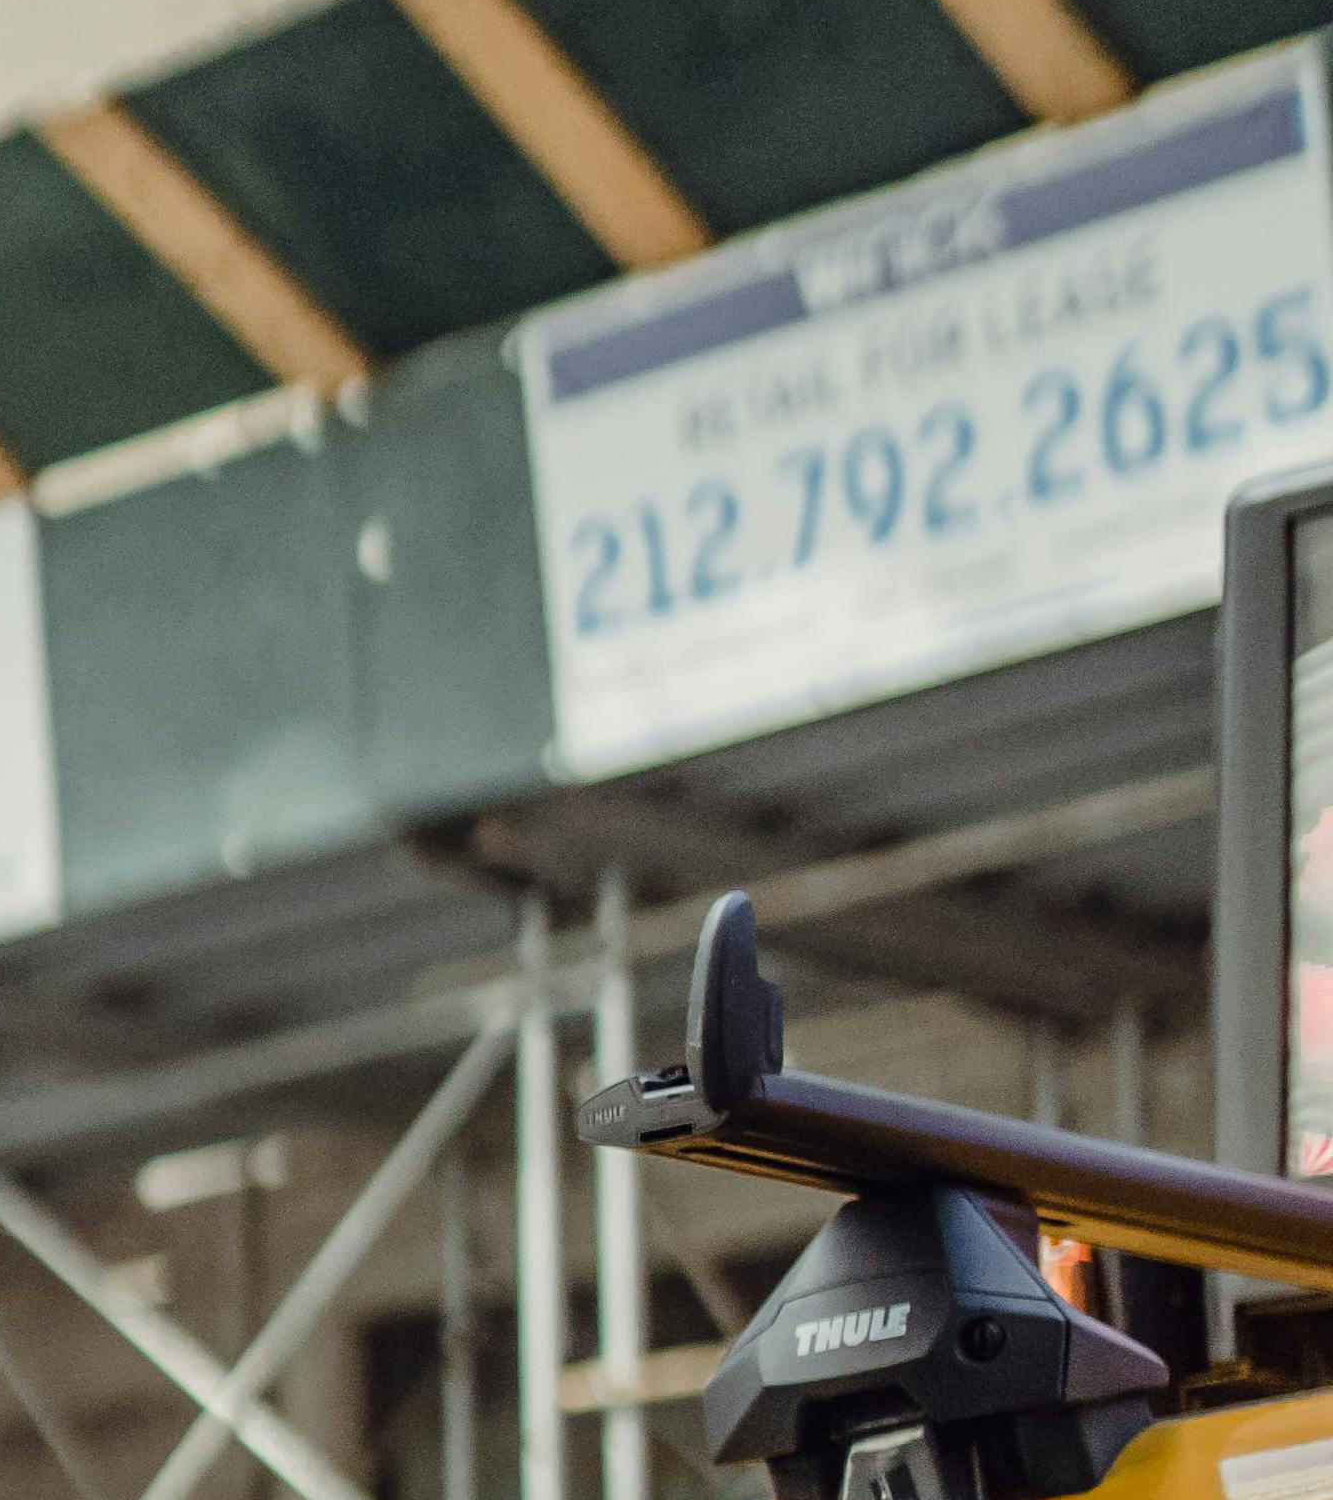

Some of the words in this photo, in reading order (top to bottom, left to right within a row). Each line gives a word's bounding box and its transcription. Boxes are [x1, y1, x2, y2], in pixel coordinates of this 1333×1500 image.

[860, 314, 965, 388] FOR
[983, 240, 1161, 350] LEASE
[570, 283, 1330, 637] 212.792.2625
[795, 1301, 911, 1357] THULE
